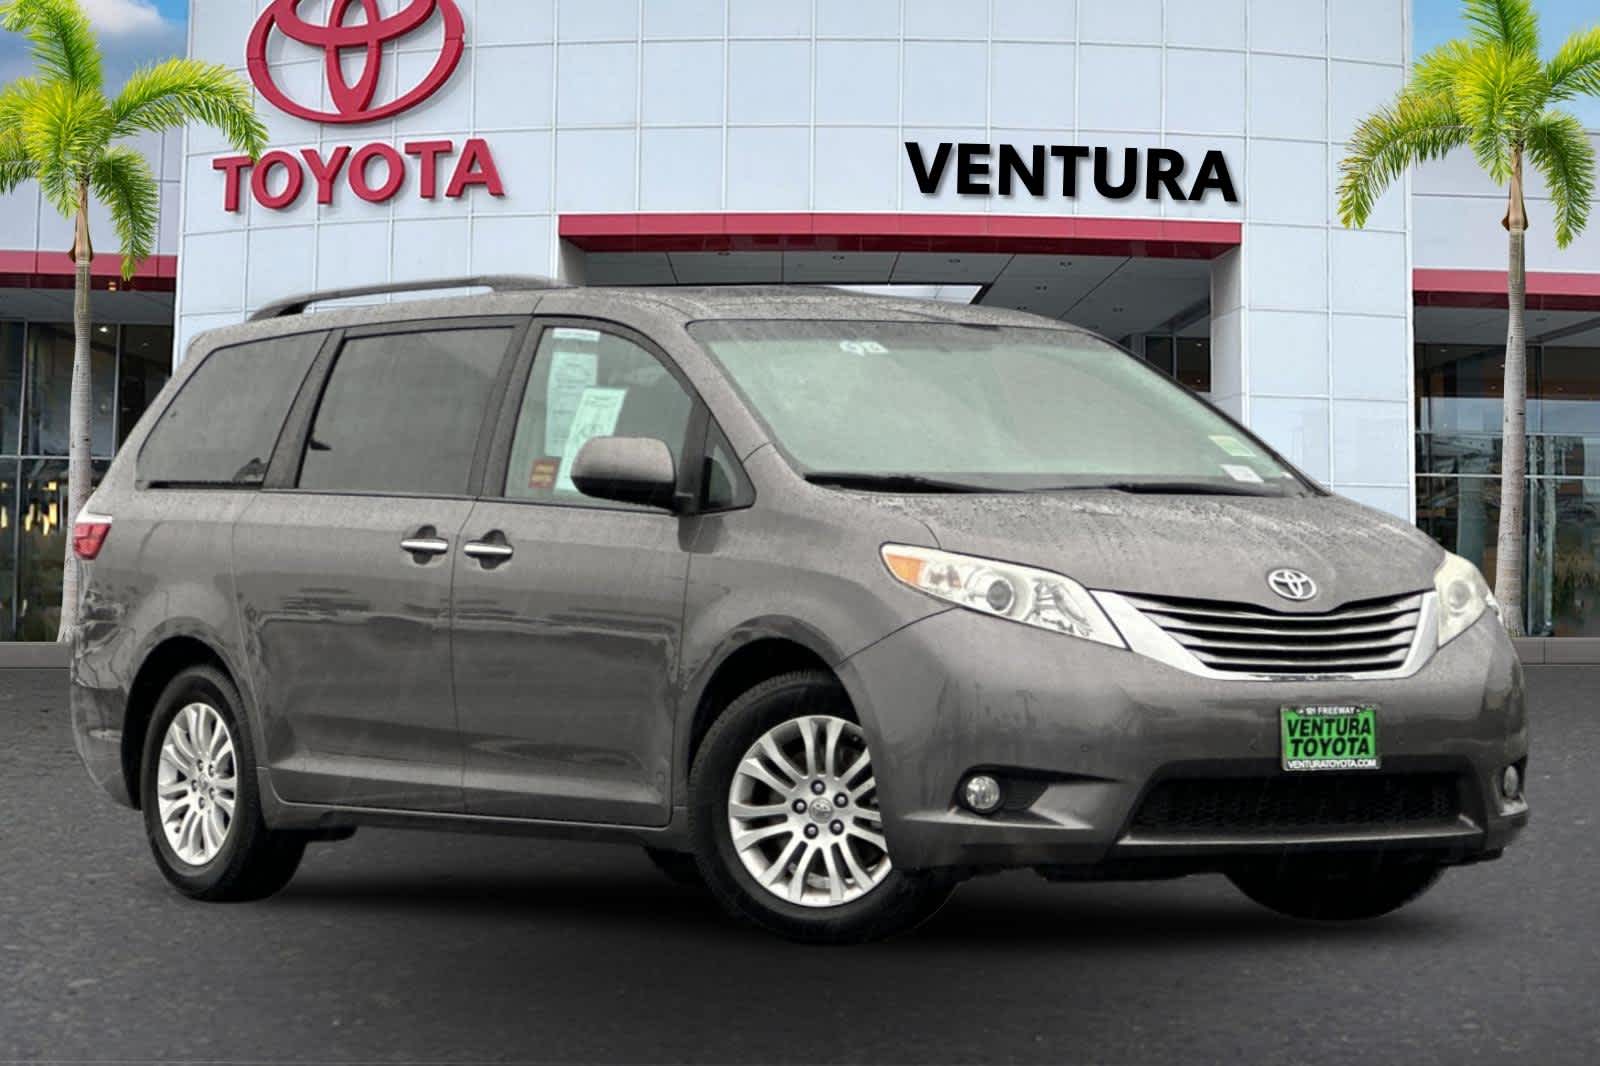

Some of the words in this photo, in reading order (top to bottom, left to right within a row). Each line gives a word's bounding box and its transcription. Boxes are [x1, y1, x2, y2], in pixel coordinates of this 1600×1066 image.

[212, 139, 505, 212] TOYOTA
[904, 141, 1239, 203] VENTURA
[1287, 717, 1371, 737] VENTURA
[1290, 737, 1370, 757] TOYOTA
